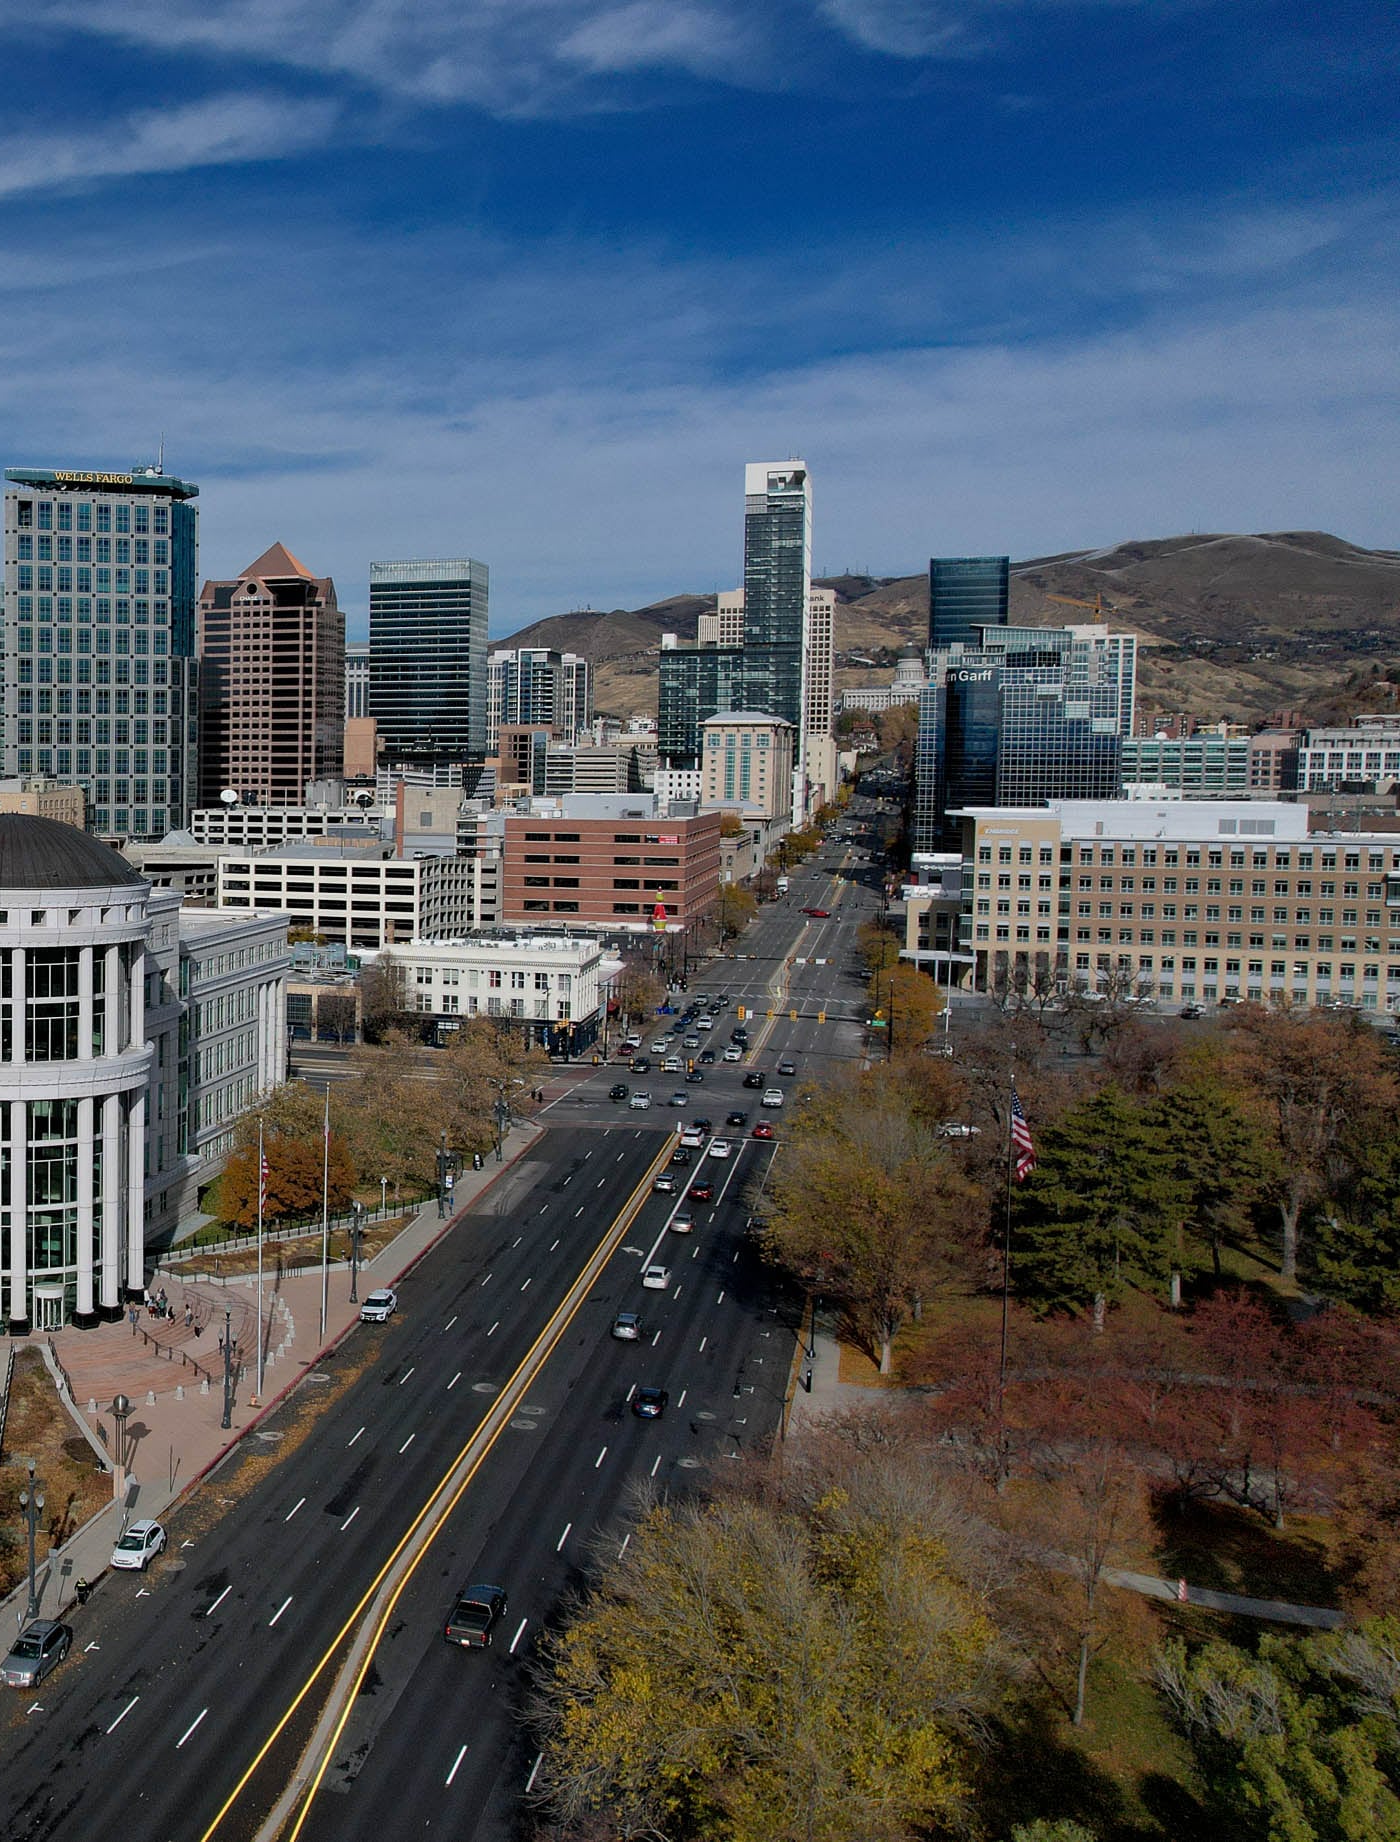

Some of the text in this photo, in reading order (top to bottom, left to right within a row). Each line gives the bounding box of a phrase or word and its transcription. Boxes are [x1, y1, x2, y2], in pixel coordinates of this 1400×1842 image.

[54, 471, 133, 485] WELLS FARGO
[958, 670, 992, 681] Garff
